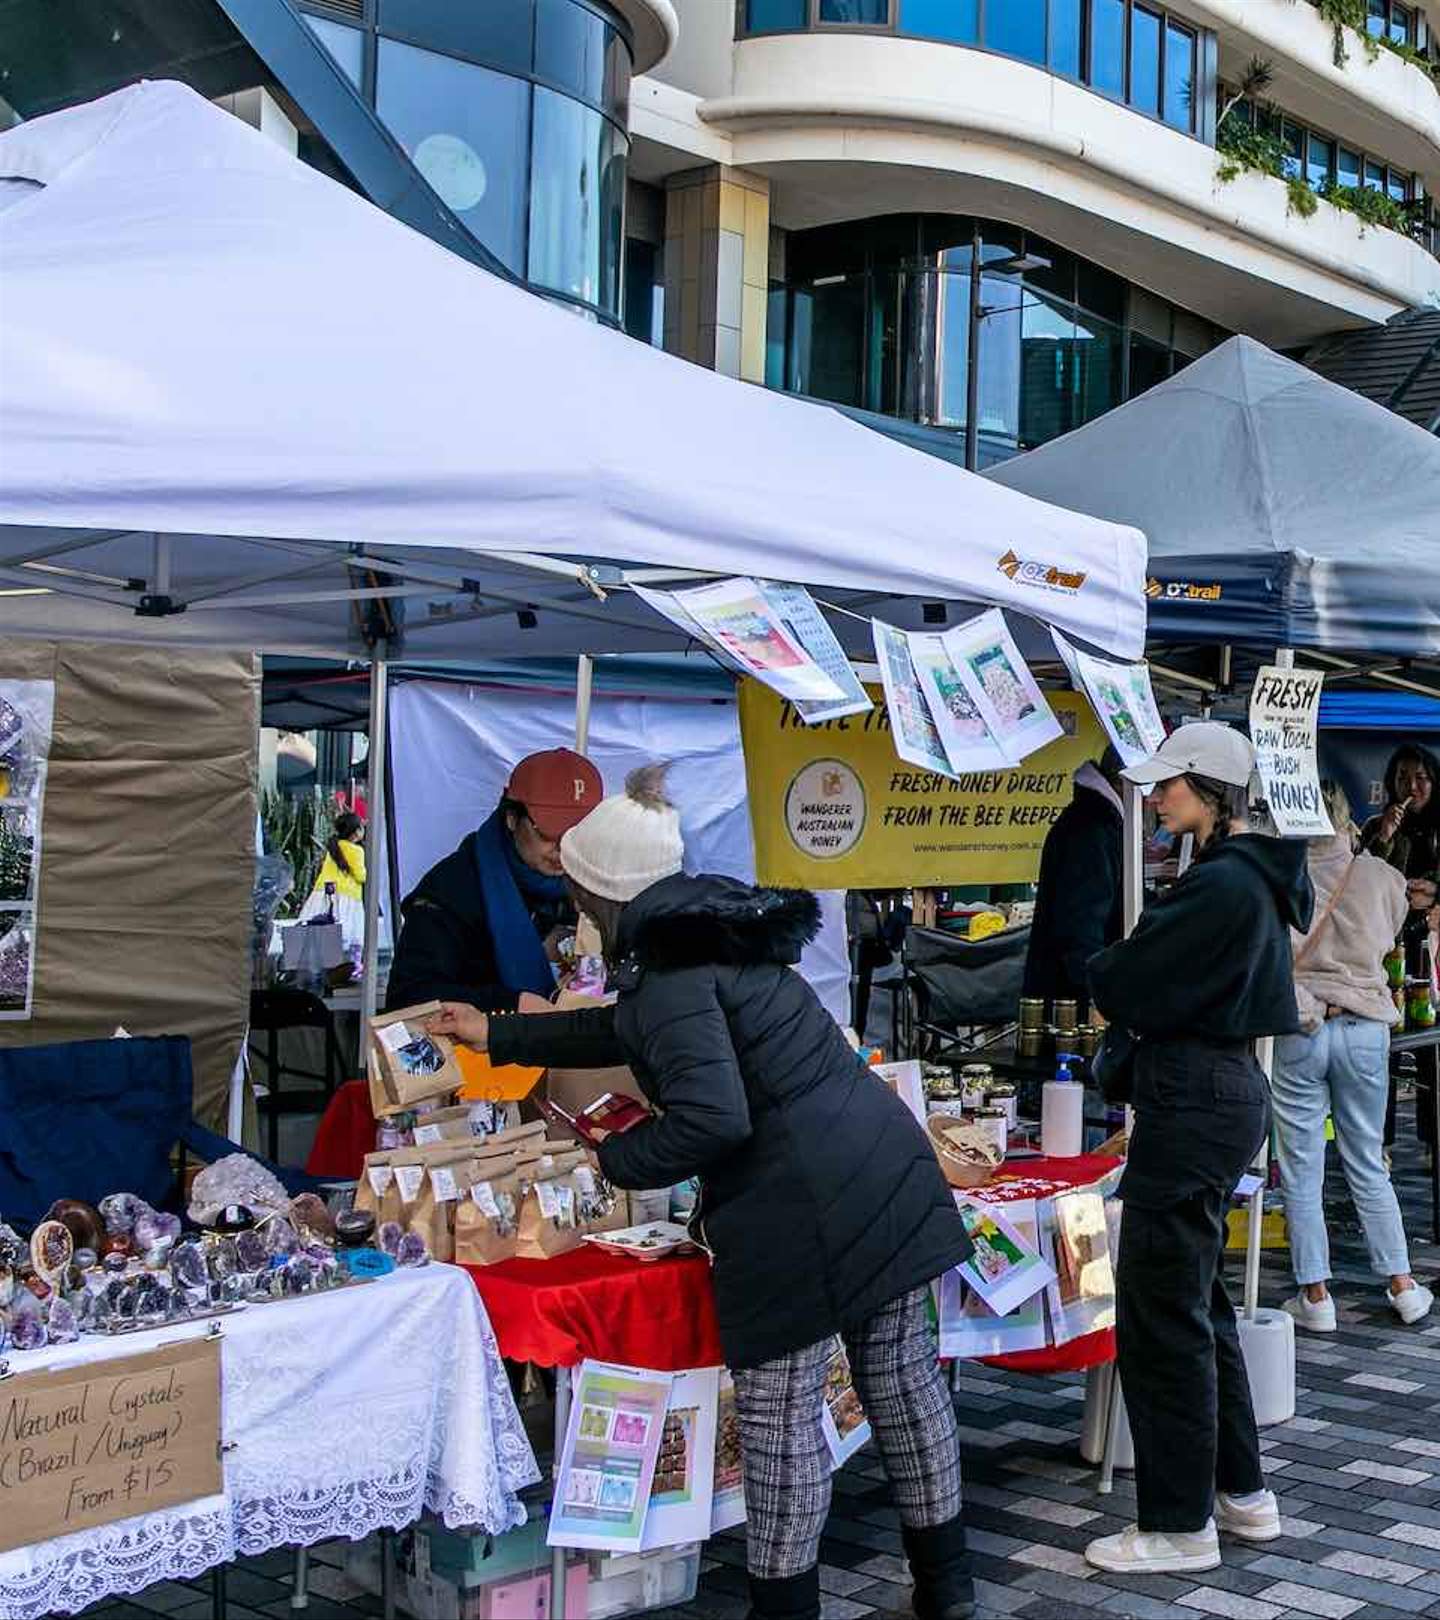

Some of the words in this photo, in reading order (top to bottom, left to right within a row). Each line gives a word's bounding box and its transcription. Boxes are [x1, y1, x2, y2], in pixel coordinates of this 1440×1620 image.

[1255, 677, 1318, 711] FRESH
[1255, 729, 1281, 749] RAW
[1283, 728, 1312, 750] LOCAL
[1273, 753, 1300, 775] BUSH
[890, 772, 943, 793] FRESH
[1007, 773, 1067, 794] DIRECT
[1269, 779, 1319, 815] HONEY
[801, 802, 851, 815] WANDERER
[883, 805, 933, 826] FROM
[939, 805, 970, 827] THE
[974, 804, 1006, 826] BEE
[1009, 806, 1063, 826] KEEPE
[797, 819, 854, 832] AUSTRALIAN
[809, 834, 842, 847] HONEY
[0, 1383, 90, 1447] Natural
[108, 1367, 185, 1422] Crystals
[64, 1475, 114, 1521] From
[122, 1458, 175, 1499] $15
